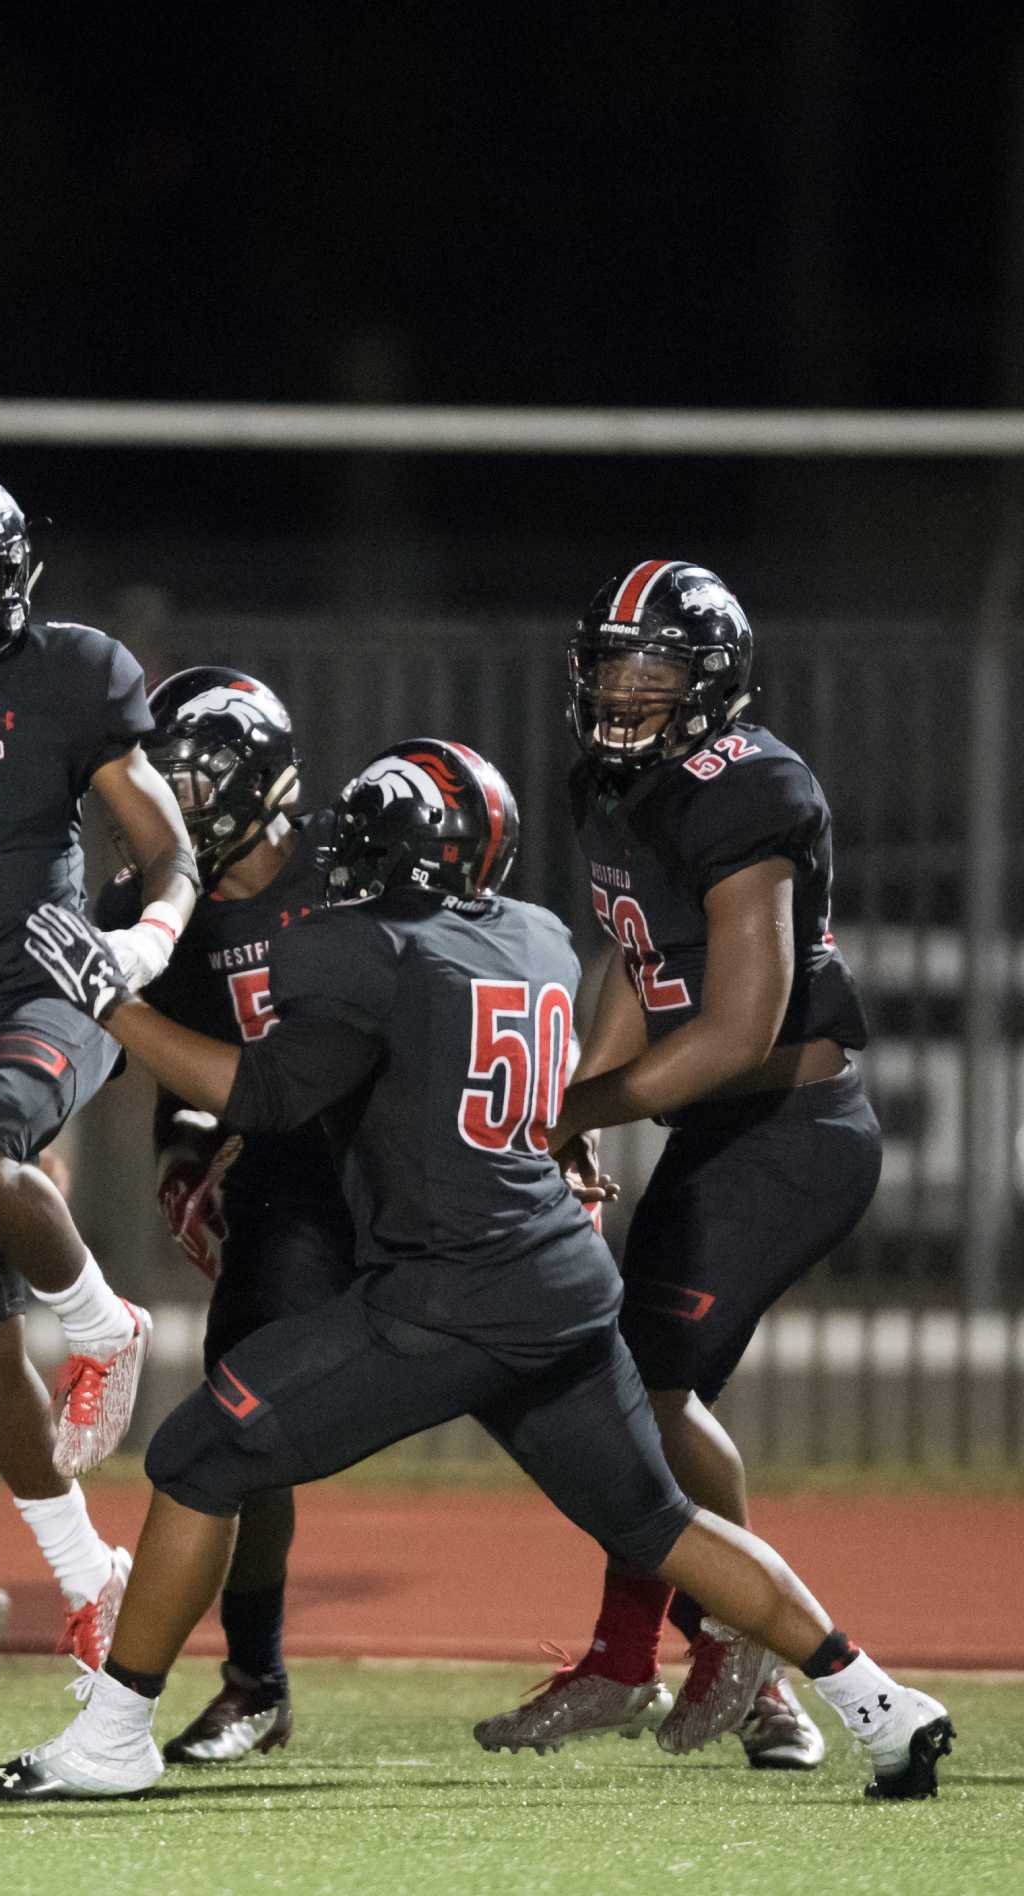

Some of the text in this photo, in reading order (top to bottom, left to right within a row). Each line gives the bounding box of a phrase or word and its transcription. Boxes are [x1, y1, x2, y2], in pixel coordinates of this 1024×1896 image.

[682, 735, 763, 781] 52
[410, 867, 430, 884] 50
[457, 978, 573, 1156] 50
